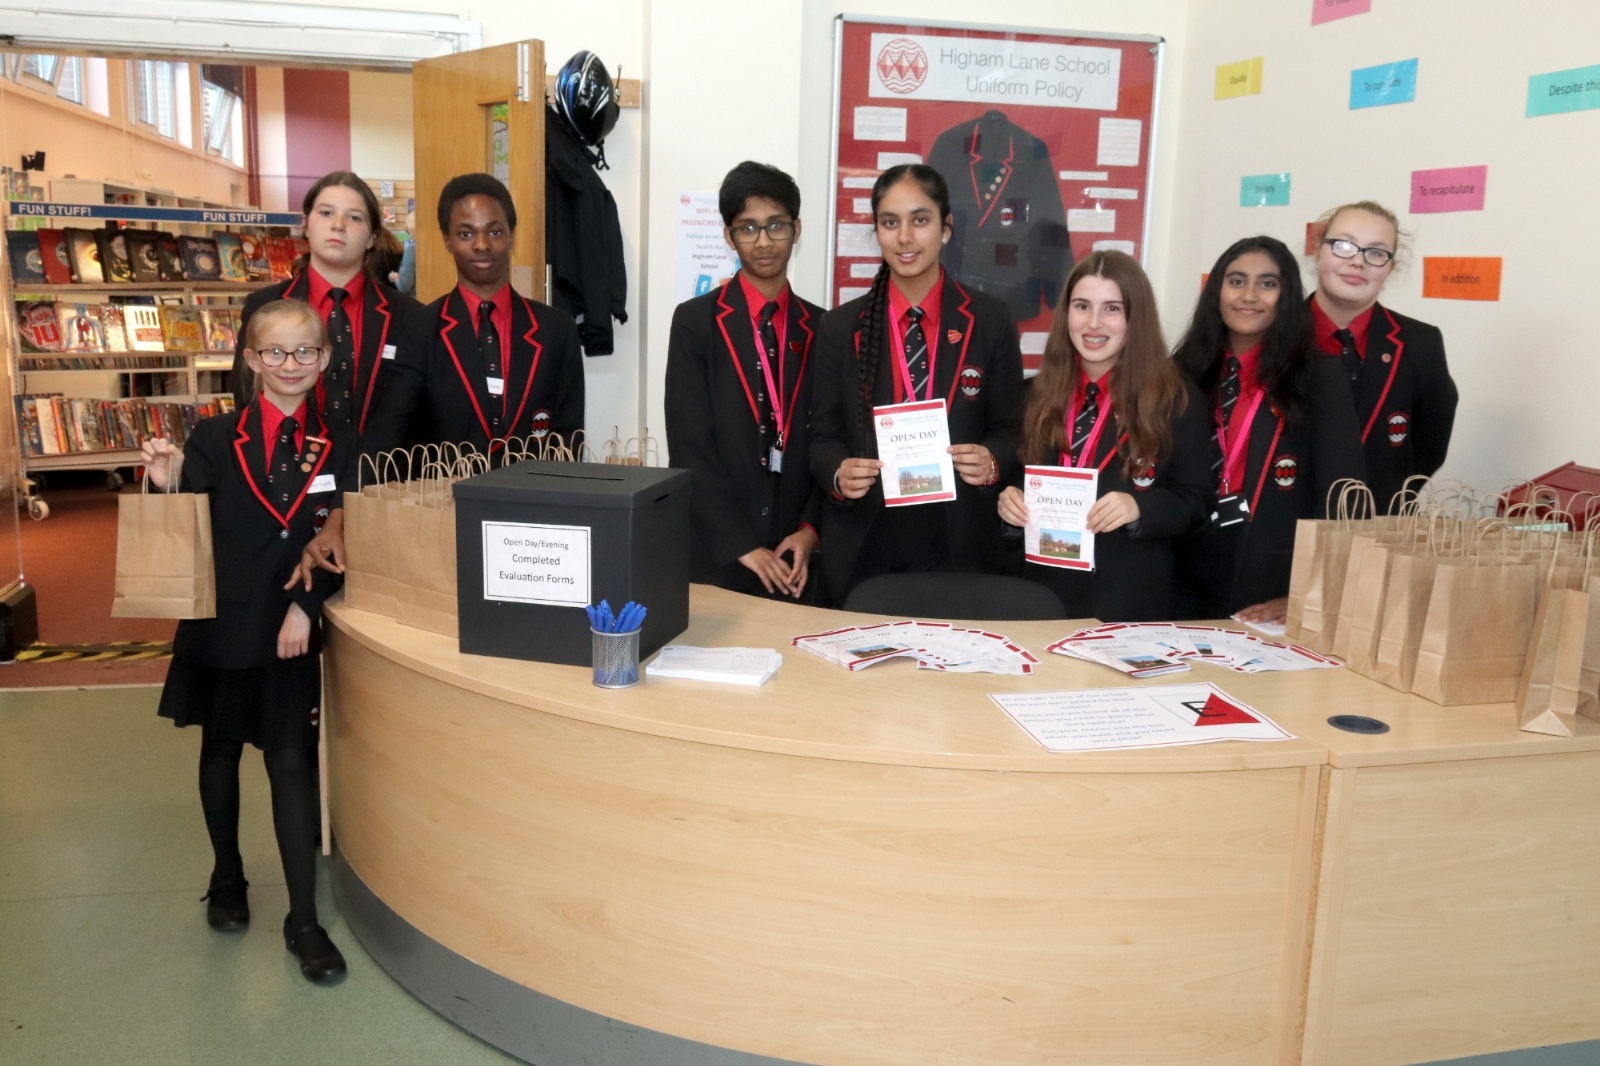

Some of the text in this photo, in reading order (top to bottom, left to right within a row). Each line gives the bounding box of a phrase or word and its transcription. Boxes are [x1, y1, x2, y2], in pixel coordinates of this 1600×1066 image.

[940, 48, 1111, 75] Higham Lane School
[966, 76, 1083, 102] Uniform Policy
[1364, 82, 1372, 92] To
[1549, 82, 1583, 97] Despite
[1420, 183, 1474, 196] To recapitulate
[18, 203, 92, 217] FUN STUFF!
[203, 211, 267, 224] FUN STUFF!
[1441, 273, 1481, 285] In addition
[890, 429, 938, 443] OPEN DAY
[1037, 496, 1084, 507] OPEN DAY
[503, 537, 569, 551] Open Day/Evening
[512, 553, 561, 566] Completed
[499, 570, 575, 585] Evaluation Forms
[1181, 700, 1228, 718] E
